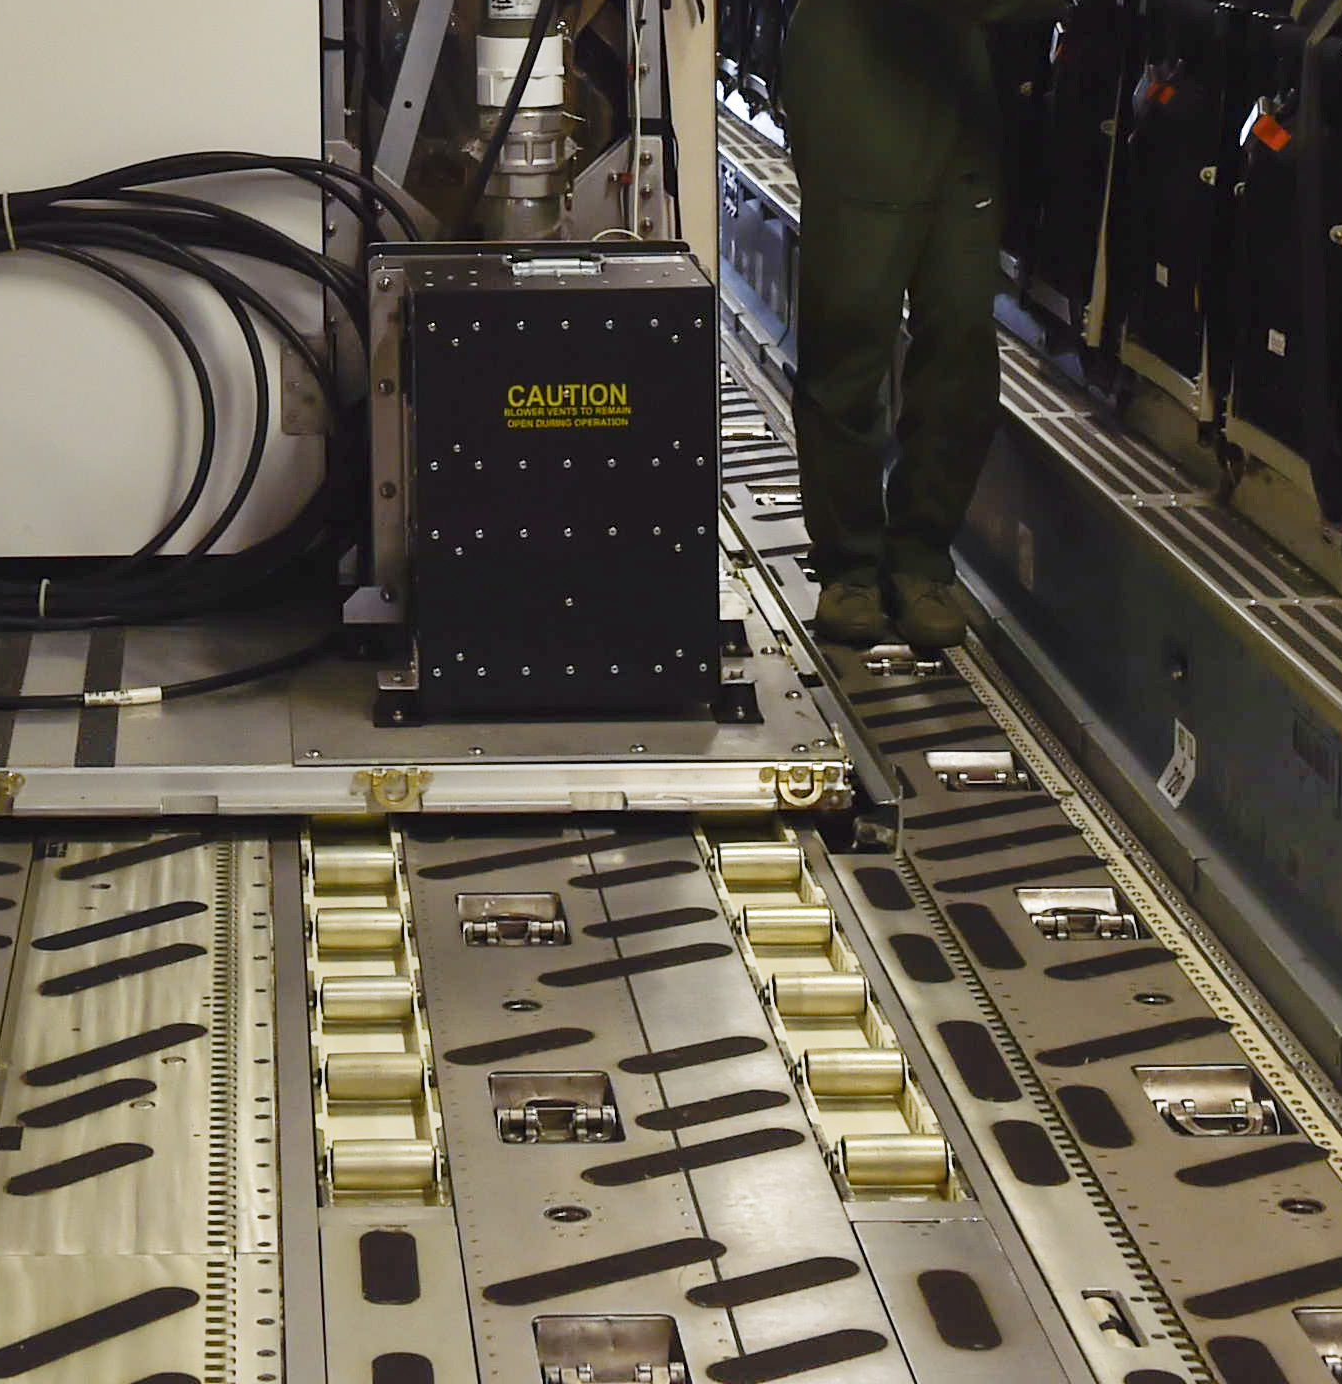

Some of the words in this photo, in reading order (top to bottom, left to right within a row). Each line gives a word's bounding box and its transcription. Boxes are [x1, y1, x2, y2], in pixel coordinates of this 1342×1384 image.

[508, 384, 627, 407] CAUTION
[504, 407, 545, 416] BLOWER
[546, 407, 577, 416] VENTS
[581, 407, 592, 415] TO
[595, 406, 632, 415] REMAIN
[507, 419, 533, 428] OPEN
[535, 419, 572, 428] DURING
[574, 418, 628, 427] OPERATION
